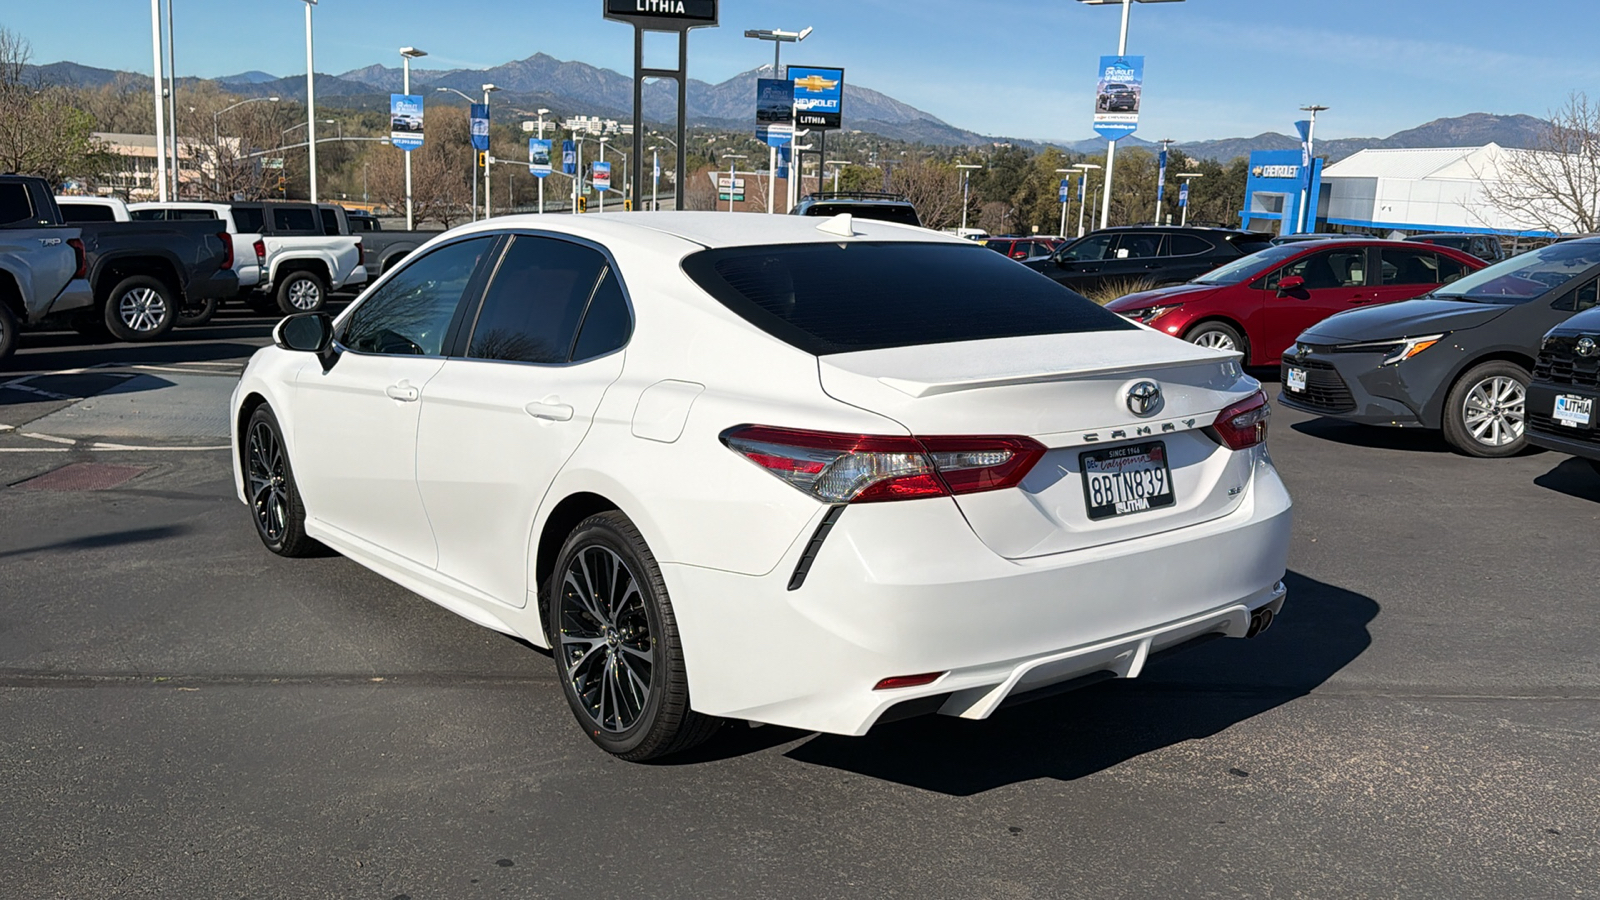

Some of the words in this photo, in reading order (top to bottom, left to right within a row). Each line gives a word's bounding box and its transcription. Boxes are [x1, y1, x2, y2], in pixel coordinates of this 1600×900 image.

[636, 0, 685, 14] LITHIA
[800, 116, 826, 125] LITHIA
[1263, 165, 1299, 178] CHEVROLET
[38, 237, 61, 246] TRD
[1564, 399, 1590, 415] LITHIA
[1083, 418, 1196, 442] CAMRY
[1108, 448, 1126, 458] SINCE
[1127, 446, 1140, 455] 1946
[1087, 459, 1098, 469] DEC
[1100, 454, 1149, 471] California
[1091, 466, 1165, 506] 8BTN839
[1123, 498, 1150, 512] LITHIA
